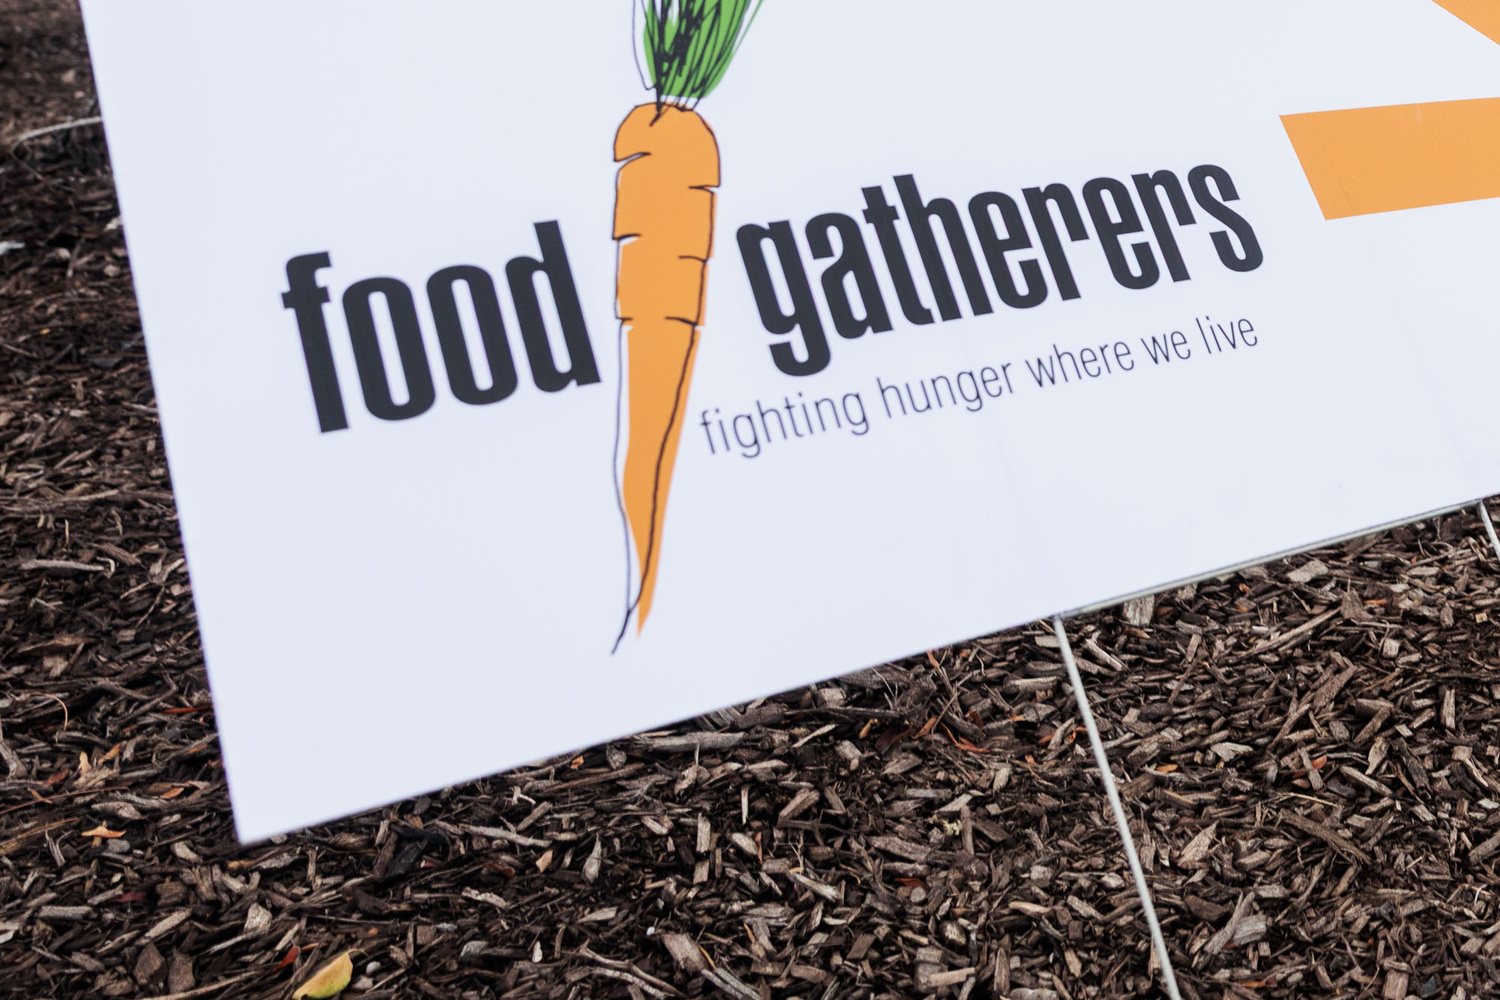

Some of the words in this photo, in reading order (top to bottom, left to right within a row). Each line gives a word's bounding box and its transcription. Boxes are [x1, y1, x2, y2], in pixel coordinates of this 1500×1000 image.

[280, 218, 603, 435] food
[736, 164, 1264, 378] gatherers
[699, 390, 870, 460] fighting
[877, 360, 1014, 419] hunger
[1023, 340, 1135, 389] where
[1141, 329, 1192, 366] we
[1196, 315, 1258, 355] live
